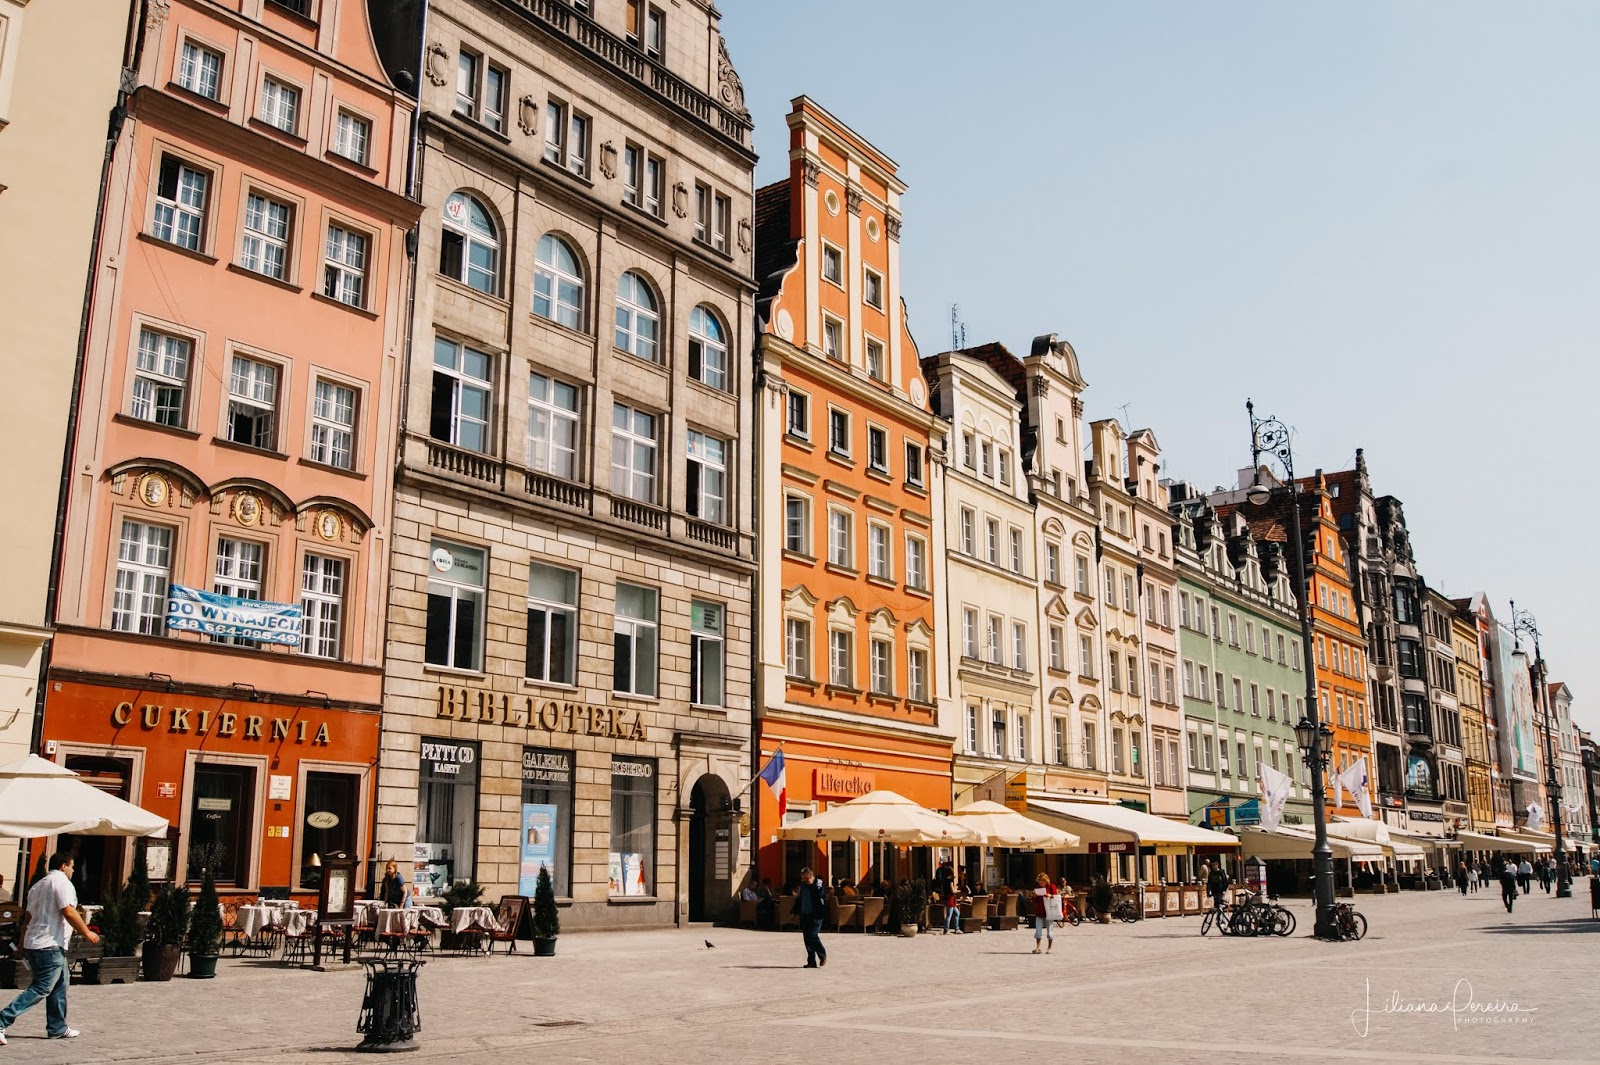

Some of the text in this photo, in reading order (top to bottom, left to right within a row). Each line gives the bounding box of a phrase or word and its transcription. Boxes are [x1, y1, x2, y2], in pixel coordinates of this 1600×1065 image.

[169, 600, 194, 615] DO
[167, 618, 200, 630] +48
[113, 701, 331, 743] CUKIERNIA
[437, 686, 647, 740] BIBLIOTEKA
[421, 743, 475, 764] PŁYTY CD
[522, 752, 570, 771] GALERIA
[522, 769, 536, 780] POD
[611, 761, 653, 778] KSERO
[821, 773, 872, 795] Literatka
[313, 813, 334, 825] Lody
